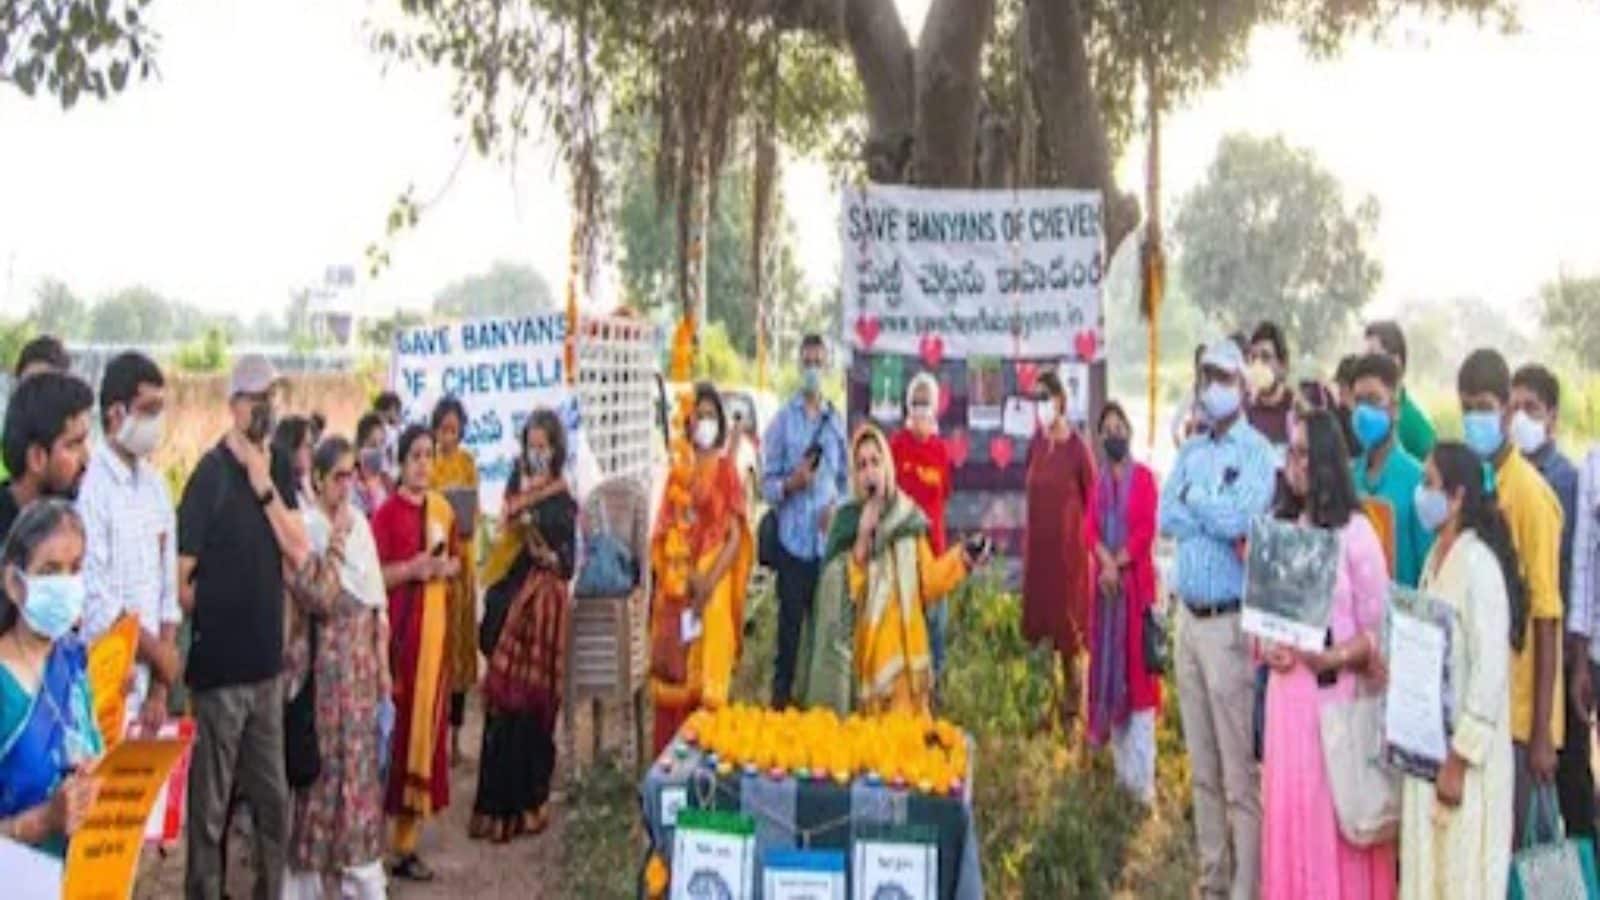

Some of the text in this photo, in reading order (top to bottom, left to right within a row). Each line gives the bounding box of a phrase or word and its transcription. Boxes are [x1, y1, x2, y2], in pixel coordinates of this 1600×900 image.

[849, 206, 898, 241] SAVE
[906, 209, 996, 242] BANYANS
[1001, 209, 1024, 241] OF
[397, 313, 567, 354] SAVE BANYANS
